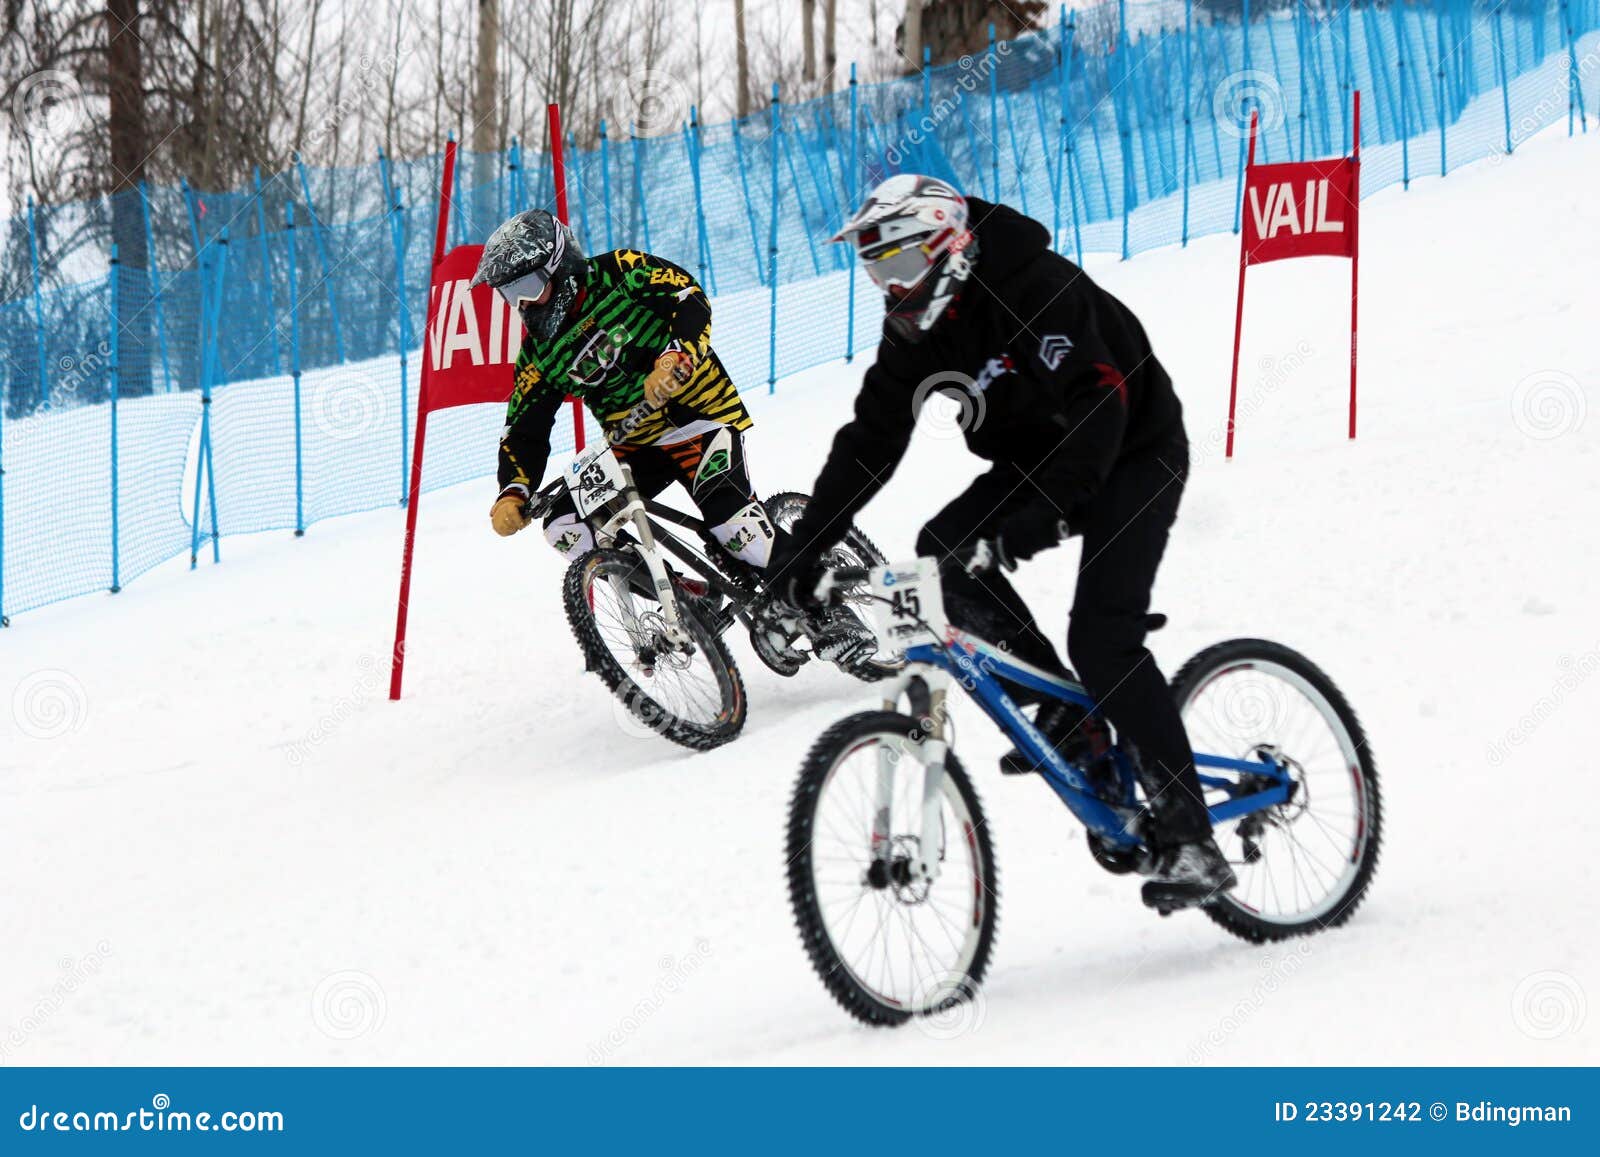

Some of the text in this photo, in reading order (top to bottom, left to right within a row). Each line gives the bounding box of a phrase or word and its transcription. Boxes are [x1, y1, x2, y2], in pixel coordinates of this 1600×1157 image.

[1249, 179, 1344, 240] VAIL
[580, 462, 606, 491] 63
[891, 588, 920, 619] 45
